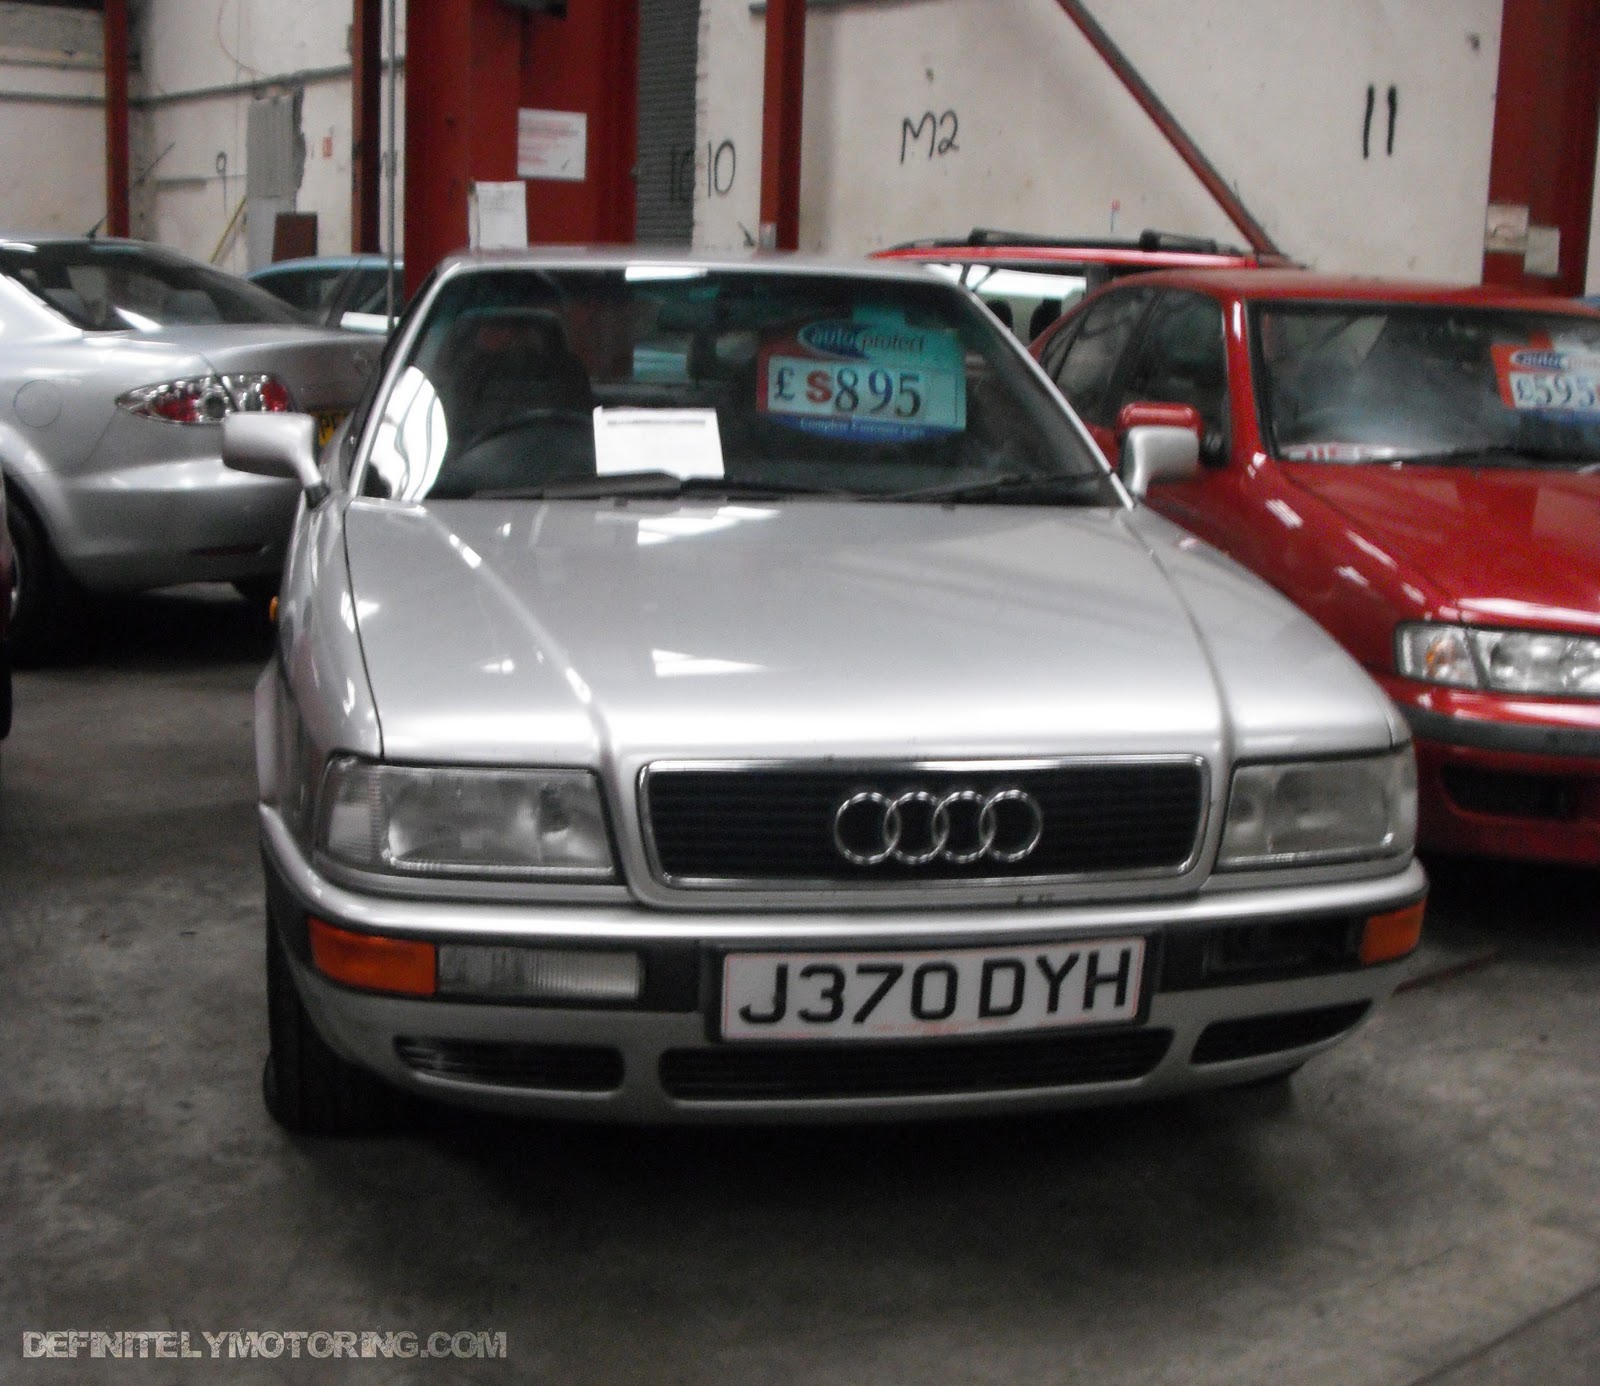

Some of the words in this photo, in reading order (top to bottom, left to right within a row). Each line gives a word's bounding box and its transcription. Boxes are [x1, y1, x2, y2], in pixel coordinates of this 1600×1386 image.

[900, 109, 960, 164] M2
[1362, 84, 1397, 159] 11
[707, 140, 736, 198] 10
[739, 961, 959, 1025] J370
[977, 947, 1133, 1019] DYH
